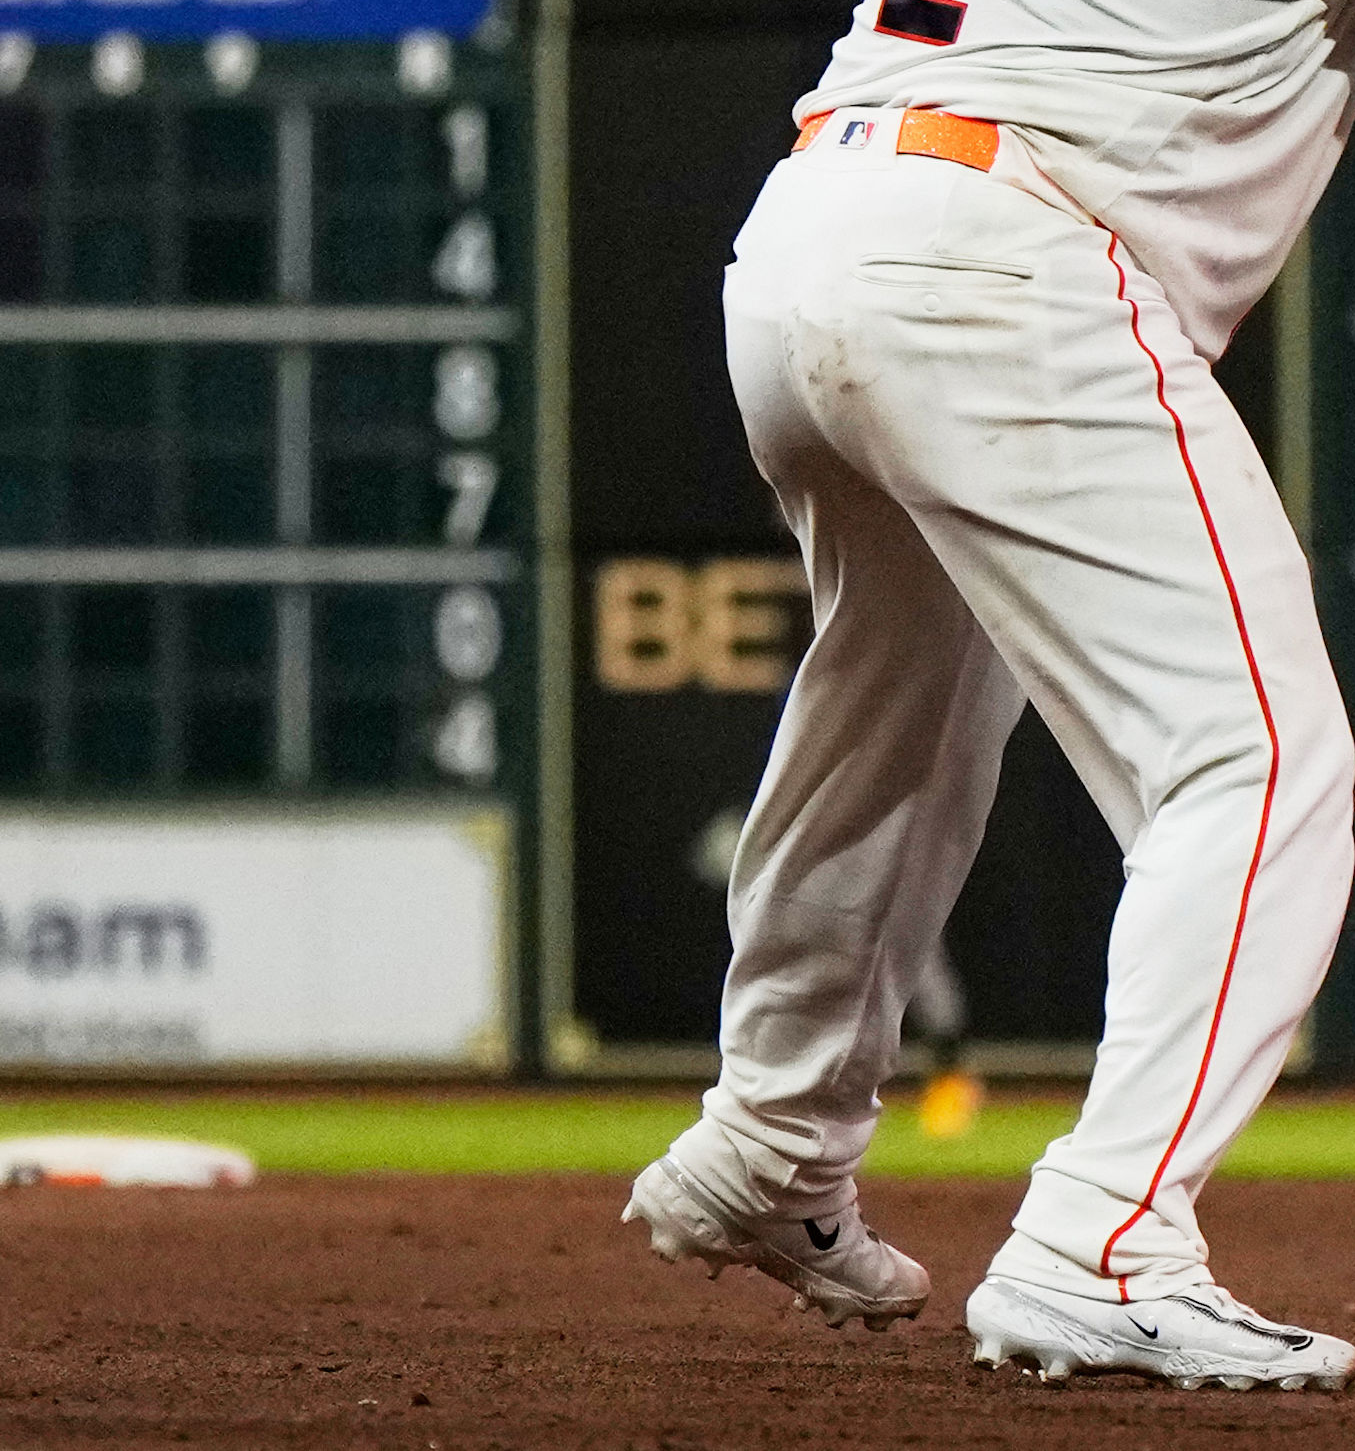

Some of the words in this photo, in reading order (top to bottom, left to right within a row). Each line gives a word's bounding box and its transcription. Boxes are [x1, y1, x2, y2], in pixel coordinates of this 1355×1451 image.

[442, 104, 488, 196] 1
[432, 212, 497, 298] 4
[437, 451, 498, 542] 7
[598, 558, 808, 694] BE
[432, 695, 497, 783] 4
[0, 898, 208, 979] am
